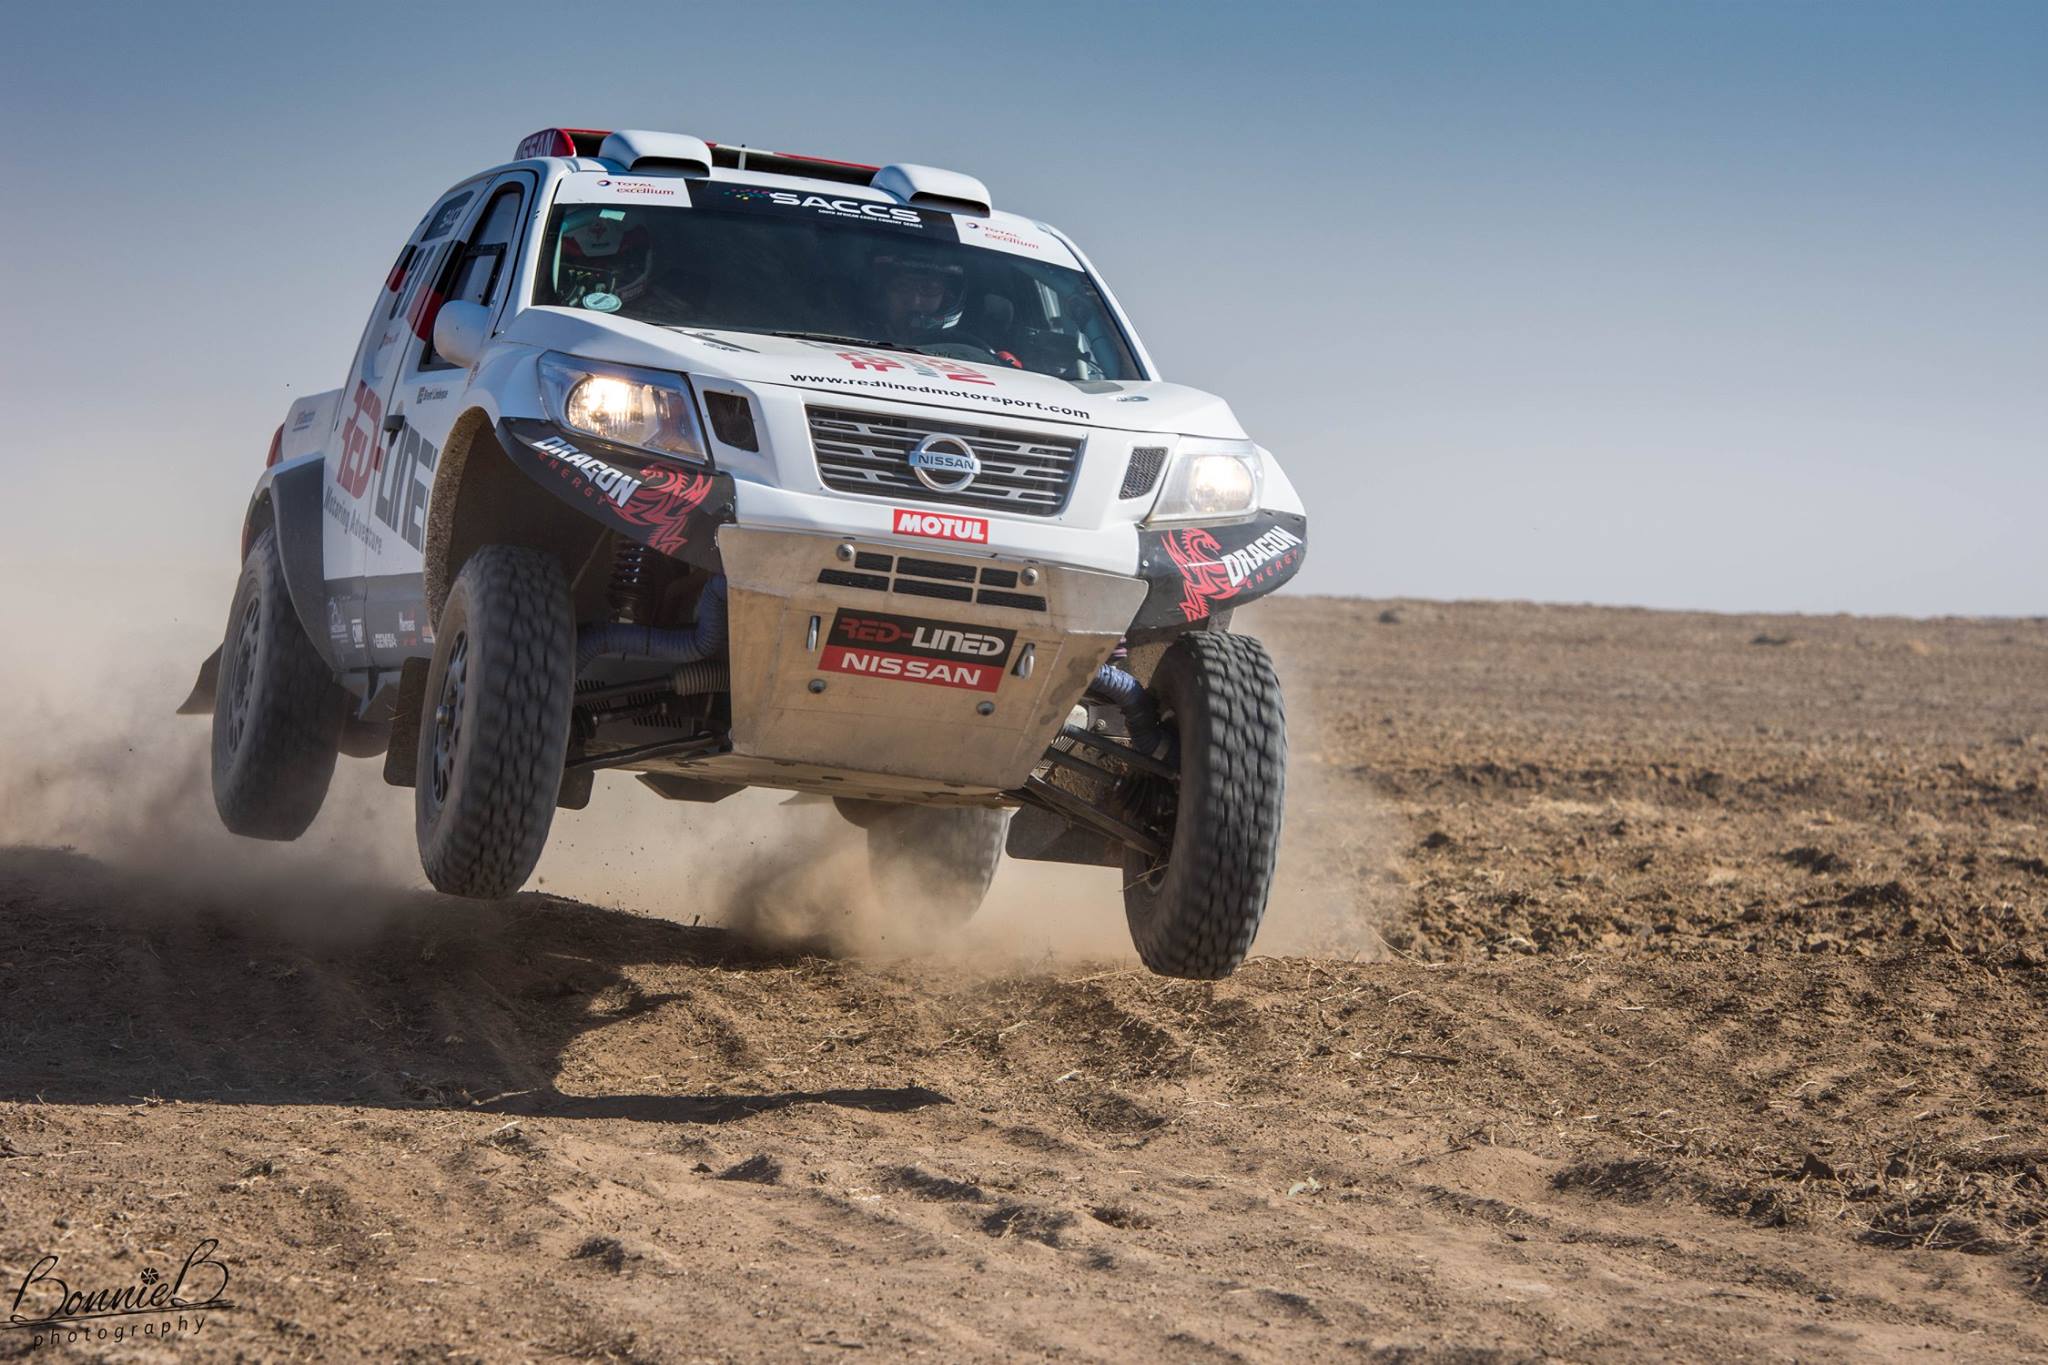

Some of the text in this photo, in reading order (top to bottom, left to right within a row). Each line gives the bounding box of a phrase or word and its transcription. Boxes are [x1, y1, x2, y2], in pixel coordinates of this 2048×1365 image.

[616, 187, 675, 196] excellium
[769, 192, 921, 223] SACCS
[790, 372, 1090, 420] www.redlinedmotorsport.com
[530, 435, 642, 508] DRAGON
[537, 451, 609, 506] ENERGY
[917, 454, 976, 470] NISSAN
[897, 512, 985, 541] MOTUL
[1220, 525, 1303, 588] DRAGON
[1246, 548, 1300, 590] ENERGY
[841, 652, 981, 686] NISSAN
